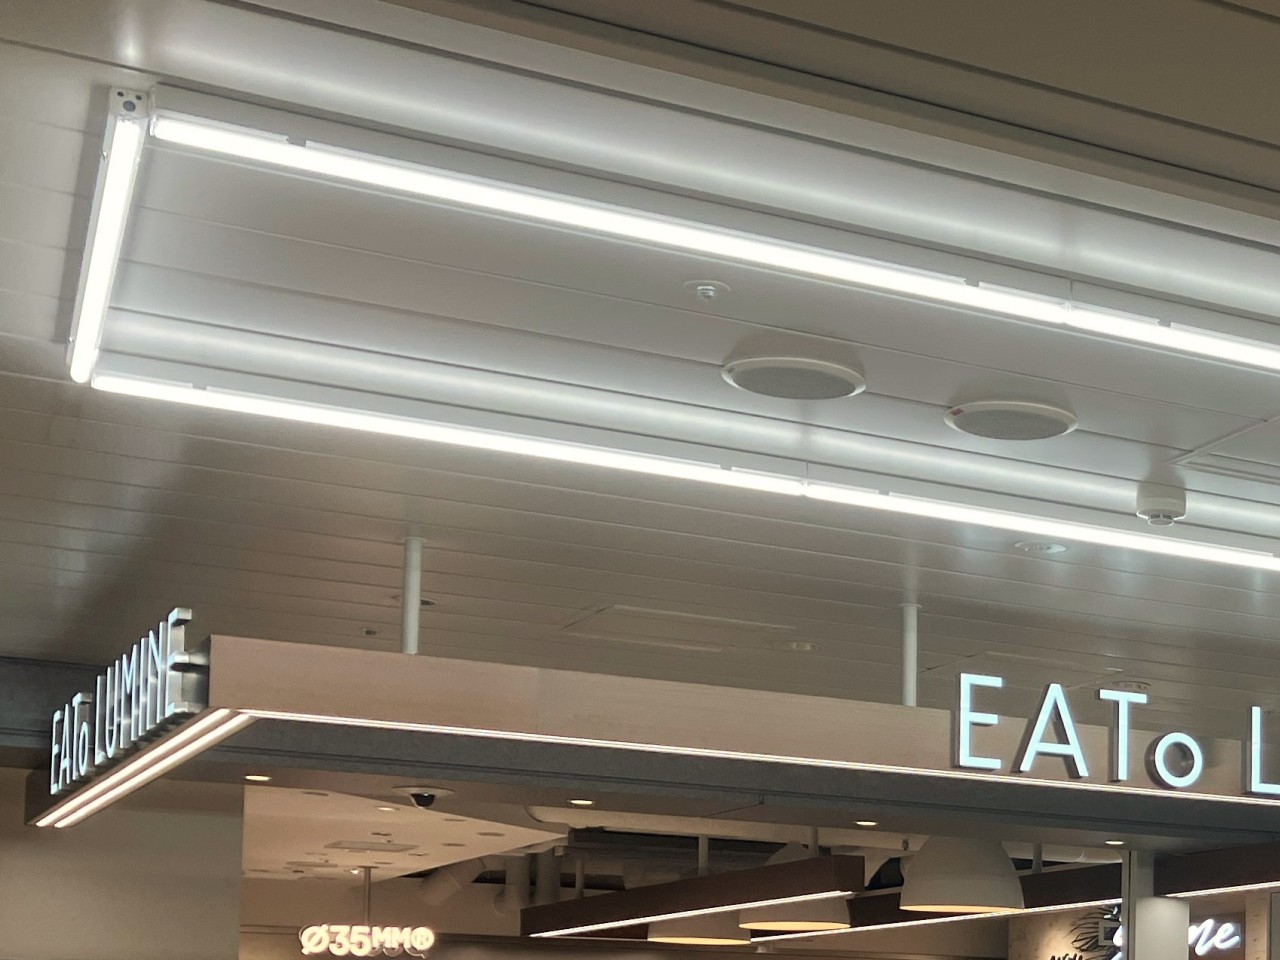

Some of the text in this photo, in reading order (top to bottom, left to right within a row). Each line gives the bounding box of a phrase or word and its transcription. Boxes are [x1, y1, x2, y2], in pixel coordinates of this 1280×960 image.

[51, 608, 192, 795] EATo LUMINE
[960, 672, 1203, 788] EATo
